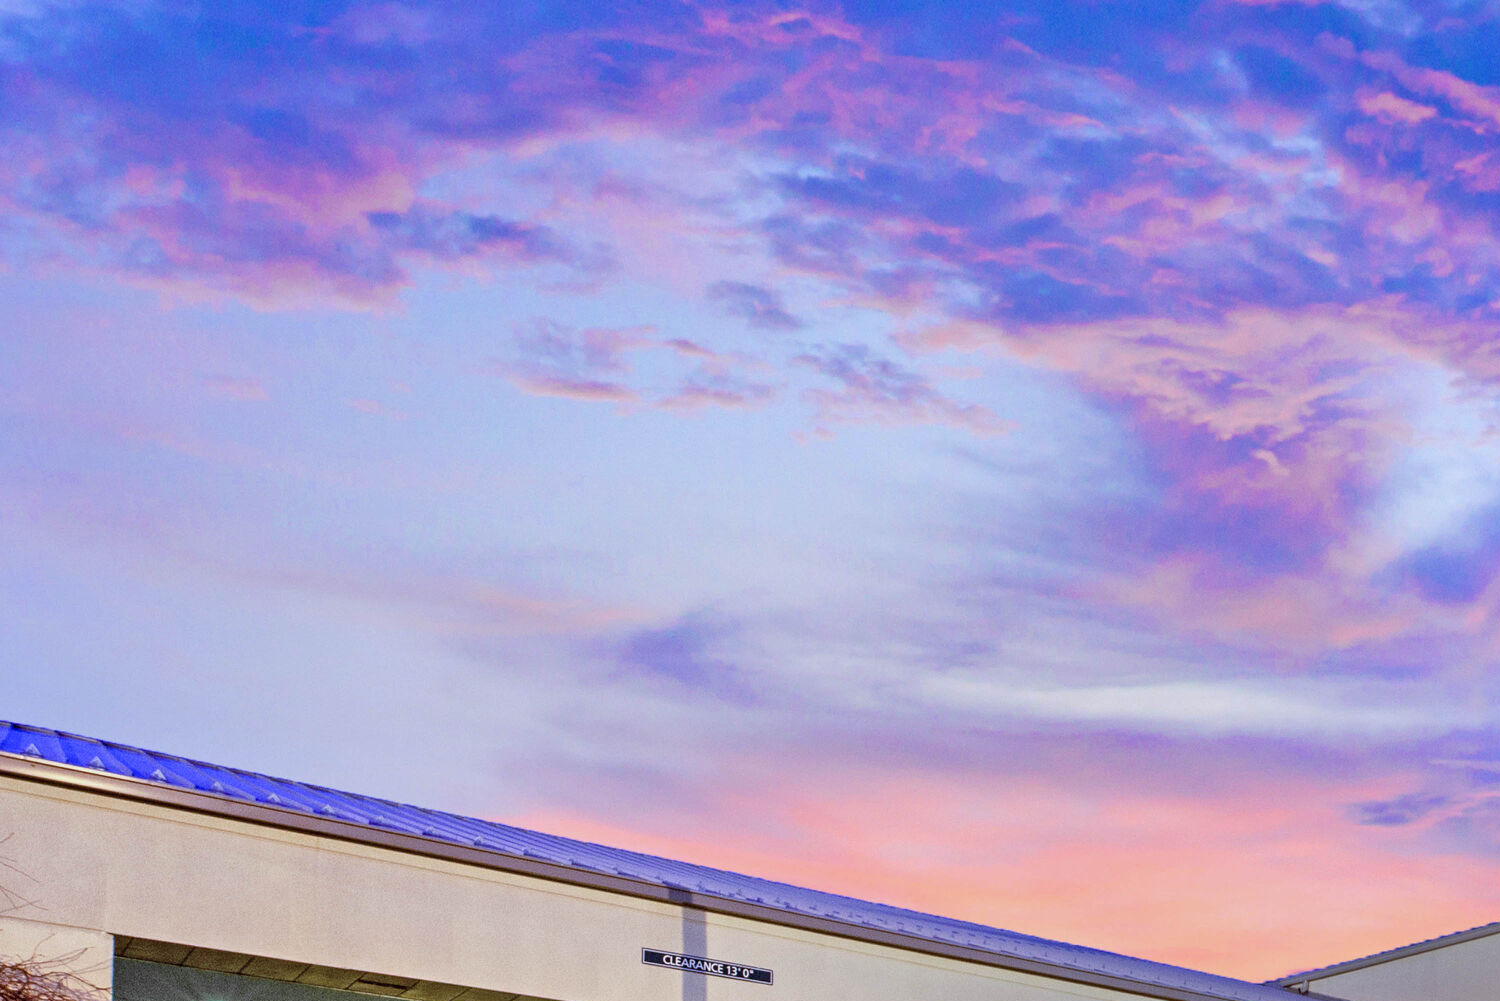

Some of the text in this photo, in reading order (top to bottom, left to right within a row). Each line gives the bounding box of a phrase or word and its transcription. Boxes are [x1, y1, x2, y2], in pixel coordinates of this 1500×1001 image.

[662, 954, 754, 978] CLEARANCE 13' 0"
